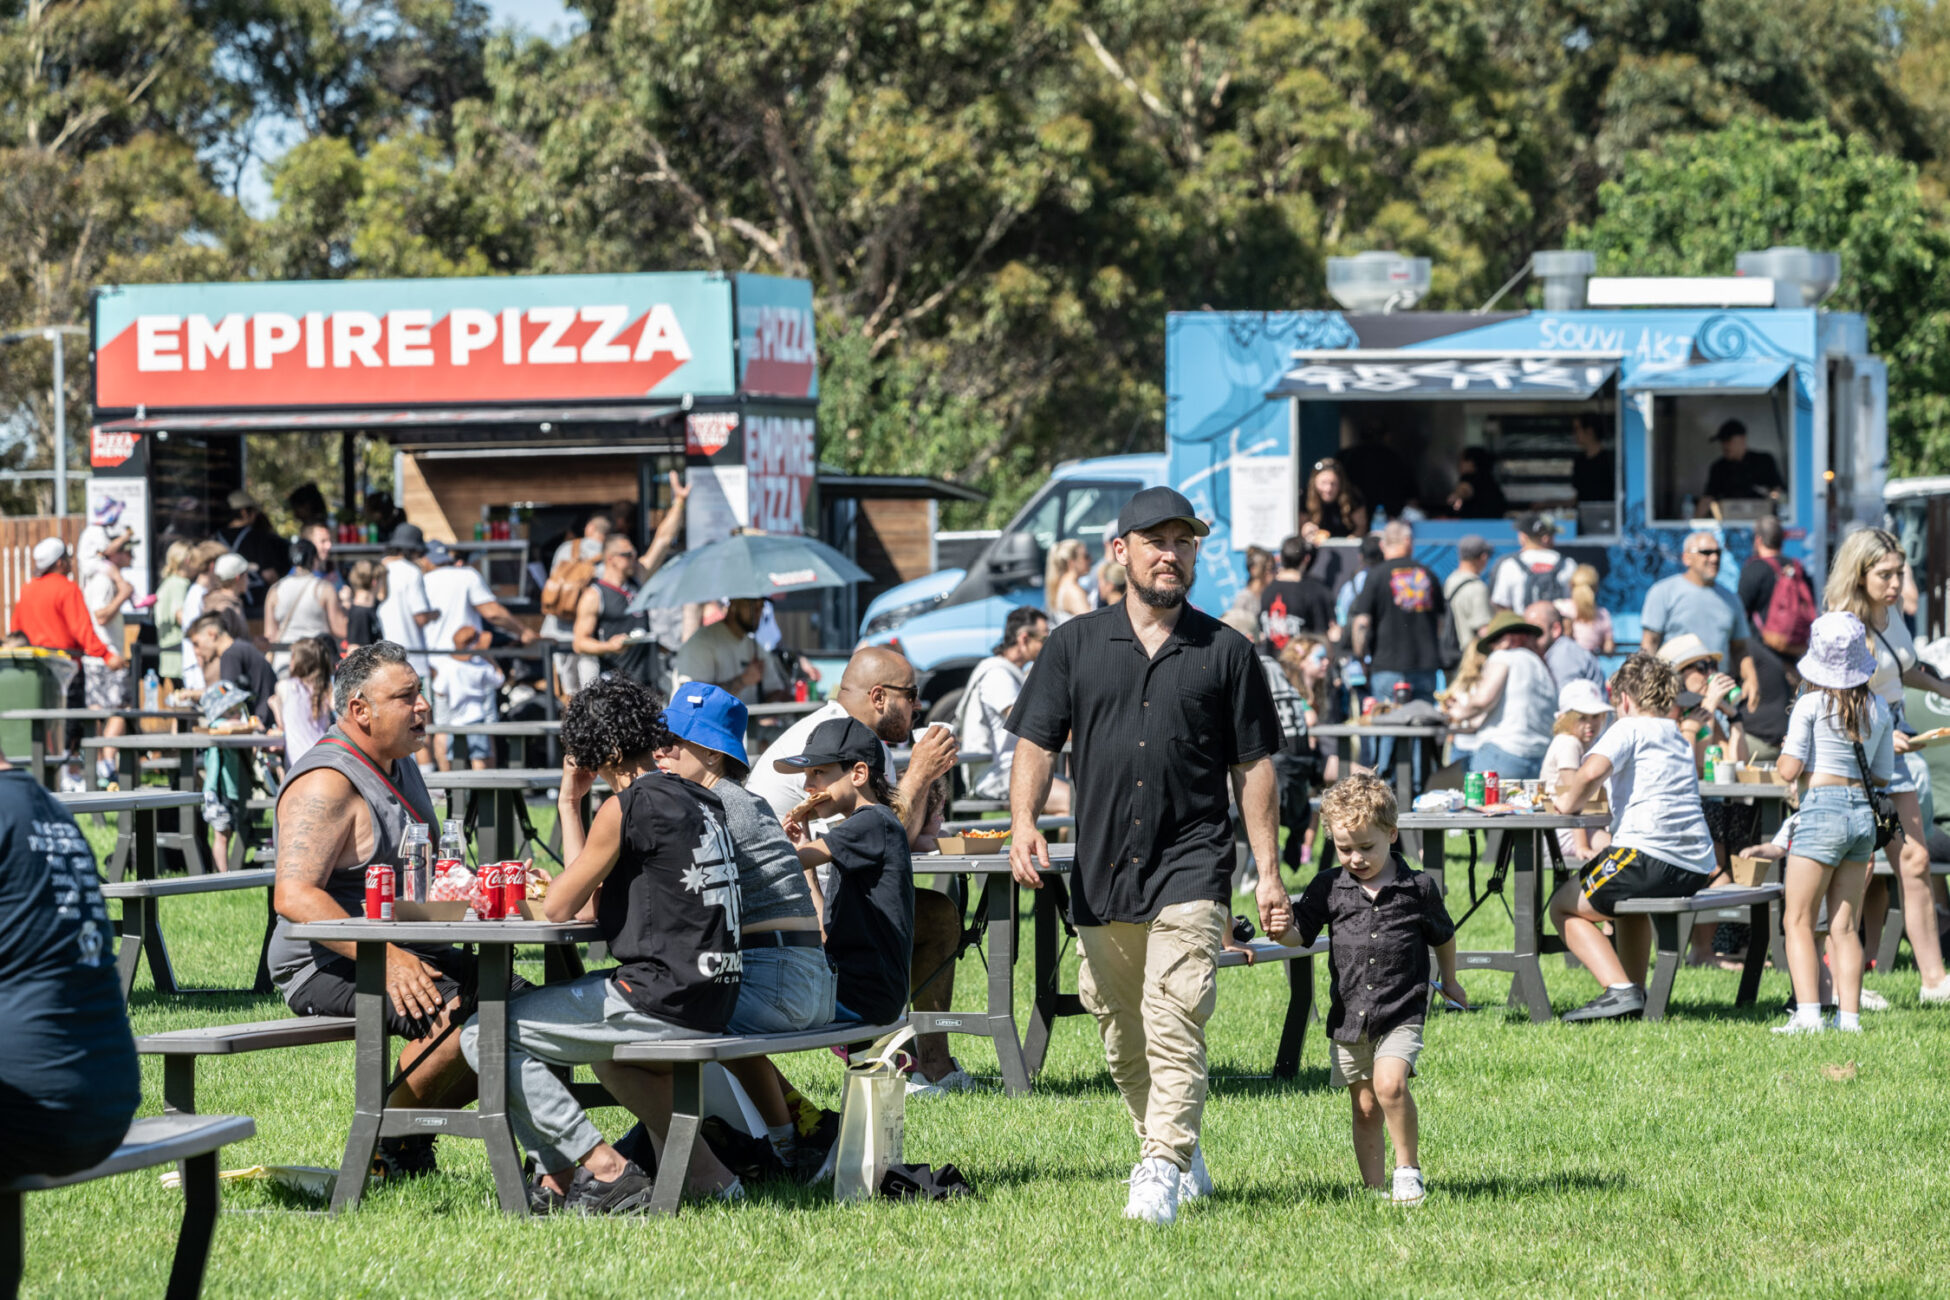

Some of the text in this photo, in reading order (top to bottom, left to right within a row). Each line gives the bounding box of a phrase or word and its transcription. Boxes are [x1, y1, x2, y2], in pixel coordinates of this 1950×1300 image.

[137, 309, 434, 372] EMPIRE
[450, 303, 693, 366] PIZZA
[759, 305, 816, 363] PIZZA
[745, 414, 815, 477] EMPIRE
[748, 474, 804, 533] PIZZA
